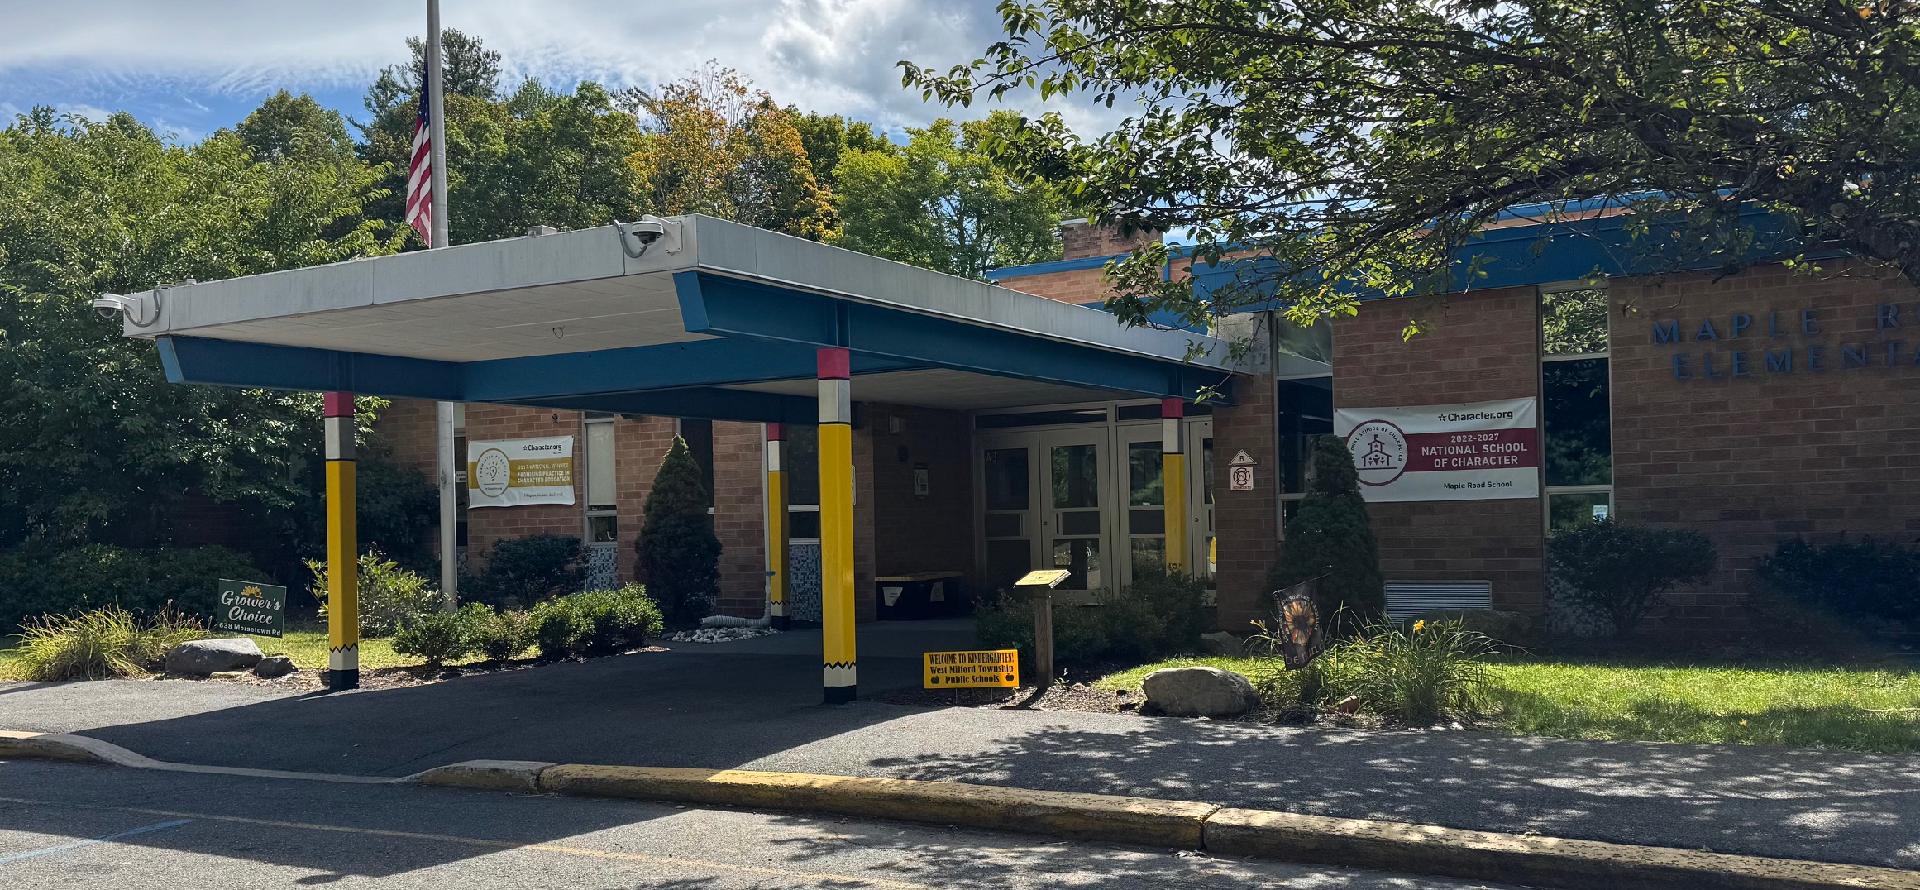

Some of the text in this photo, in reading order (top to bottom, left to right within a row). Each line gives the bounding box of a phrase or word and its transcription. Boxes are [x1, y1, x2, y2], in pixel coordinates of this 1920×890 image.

[1653, 308, 1822, 344] MAPLE
[1672, 339, 1920, 380] ELEMENT
[1448, 410, 1513, 422] Character.org
[1450, 433, 1500, 444] 2022-2027
[1421, 442, 1527, 457] NATIONAL SCHOOL
[1434, 456, 1519, 468] OF CHARACTER
[1444, 482, 1466, 491] Maple
[1487, 480, 1513, 488] School
[221, 590, 281, 610] Grower's
[228, 606, 273, 624] Choice
[929, 653, 957, 664] WELCOME
[958, 653, 966, 664] TO
[930, 666, 948, 674] West
[979, 664, 1014, 673] Township
